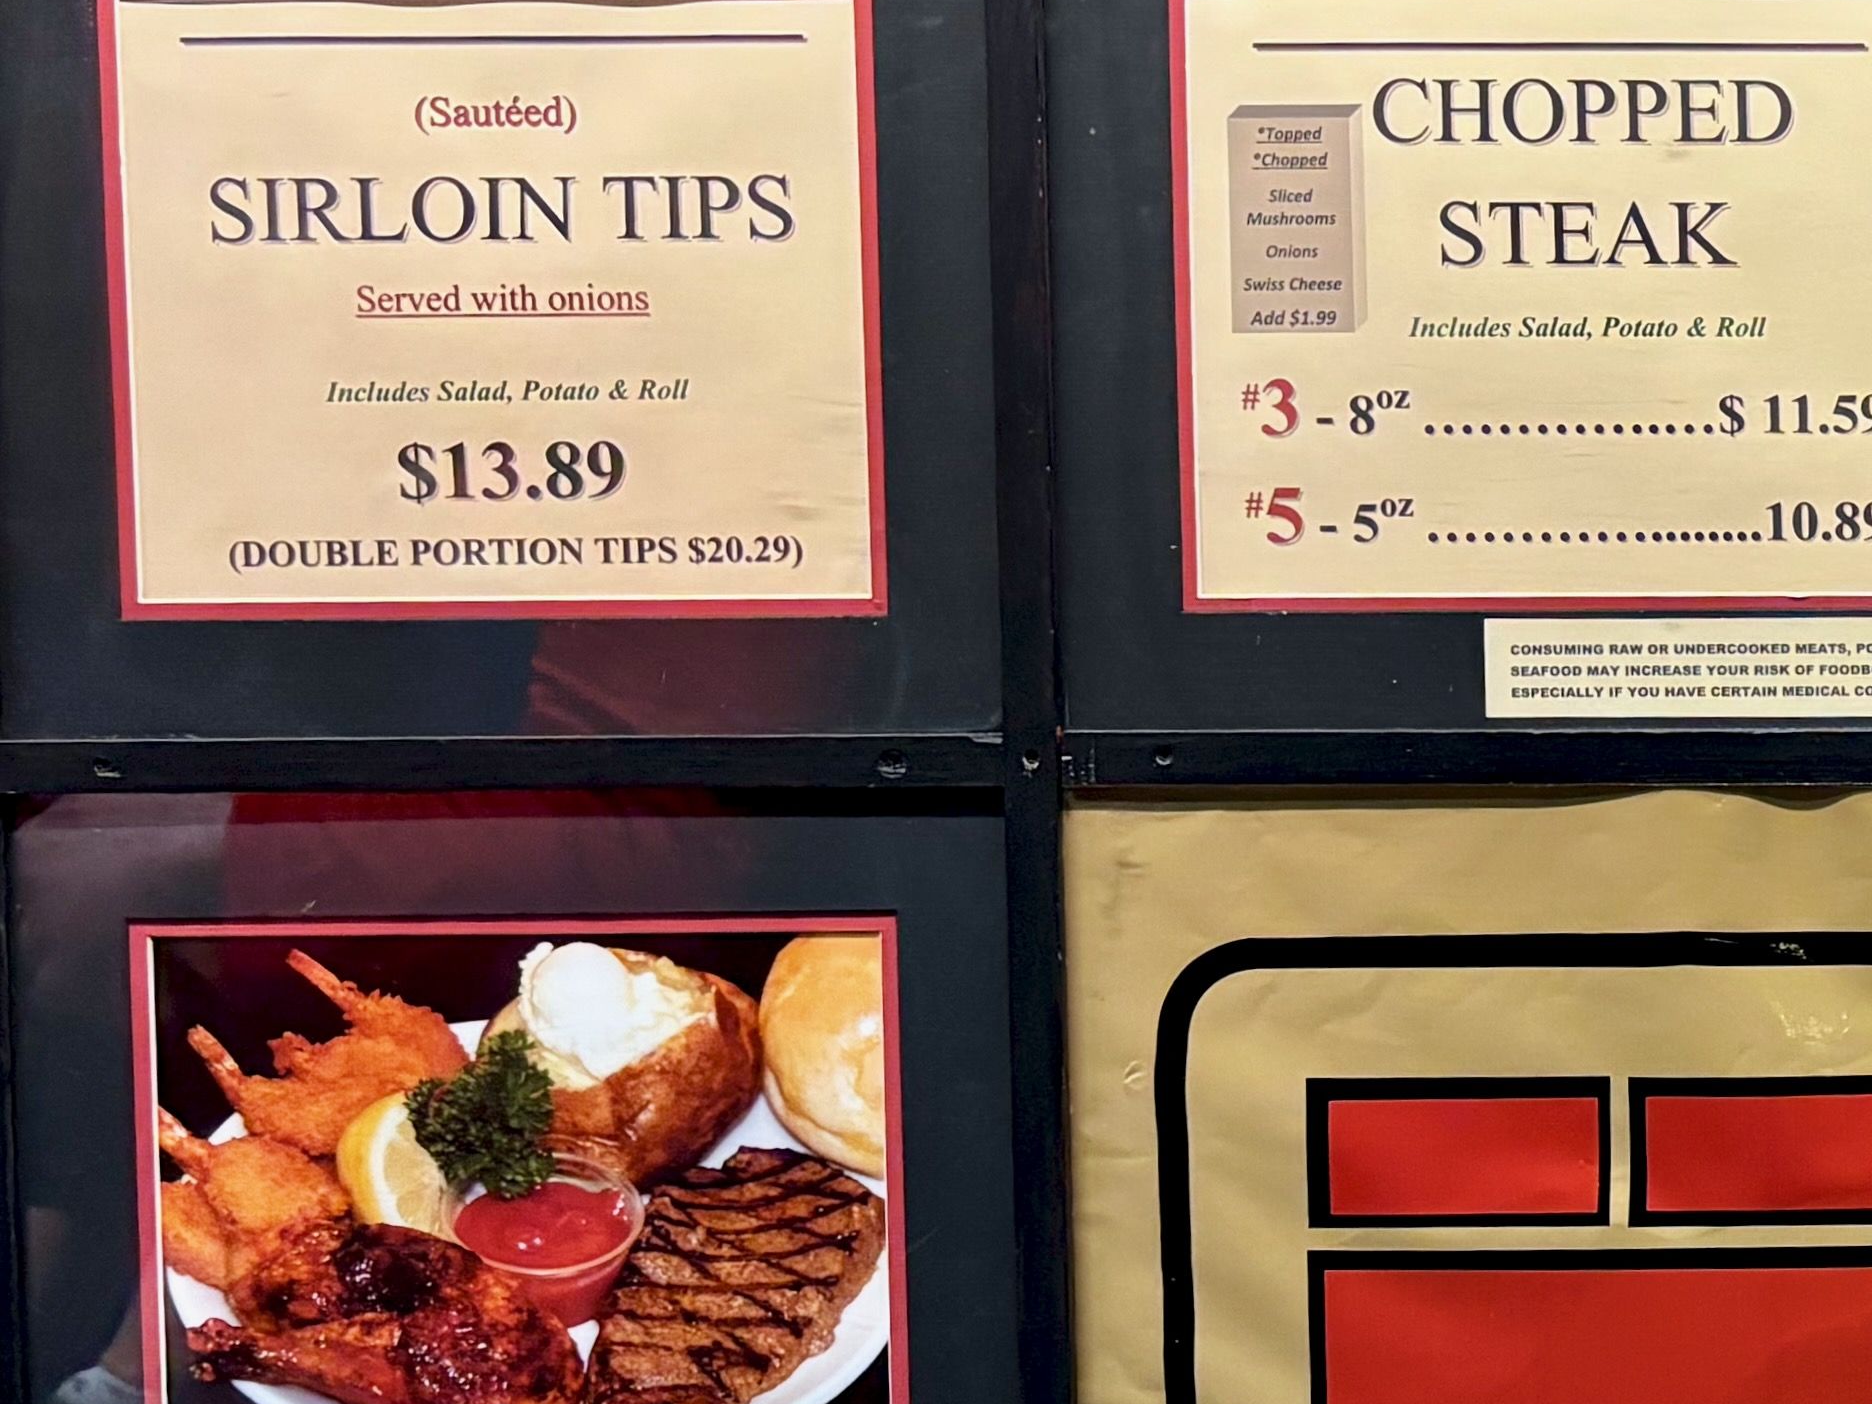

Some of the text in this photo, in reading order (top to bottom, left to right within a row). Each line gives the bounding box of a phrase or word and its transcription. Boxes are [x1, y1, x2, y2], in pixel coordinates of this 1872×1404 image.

[414, 95, 577, 136] (Sautéed)
[1372, 77, 1793, 146] CHOPPED
[1267, 188, 1314, 203] Sliced
[209, 174, 794, 245] SIRLOIN TIPS
[1246, 211, 1337, 226] Mushrooms
[1439, 200, 1738, 267] STEAK
[1265, 244, 1319, 259] Onions
[1243, 276, 1343, 292] Swiss Cheese
[355, 282, 651, 319] Served with onions
[1249, 308, 1337, 328] Add $1.99
[326, 378, 690, 405] Includes Salad, Potato Roll
[397, 440, 625, 505] $13.89
[228, 535, 803, 574] (DOUBLE PORTION TIPS $20.29)
[1510, 643, 1604, 656] CONSUMING
[1608, 643, 1644, 655] RAW
[1647, 643, 1669, 655] OR
[1673, 643, 1791, 655] UNDERCOOKED
[1795, 642, 1852, 657] MEATS,
[1510, 665, 1583, 677] SEAFOOD
[1586, 665, 1620, 677] MAY
[1624, 664, 1702, 677] INCREASE
[1706, 664, 1750, 676] YOUR
[1753, 664, 1790, 676] RISK
[1794, 664, 1815, 676] OF
[1511, 686, 1604, 699] ESPECIALLY
[1608, 686, 1623, 698] IF
[1626, 686, 1660, 698] YOU
[1664, 686, 1707, 698] HAVE
[1710, 685, 1778, 698] CERTAIN
[1782, 685, 1850, 697] MEDICAL
